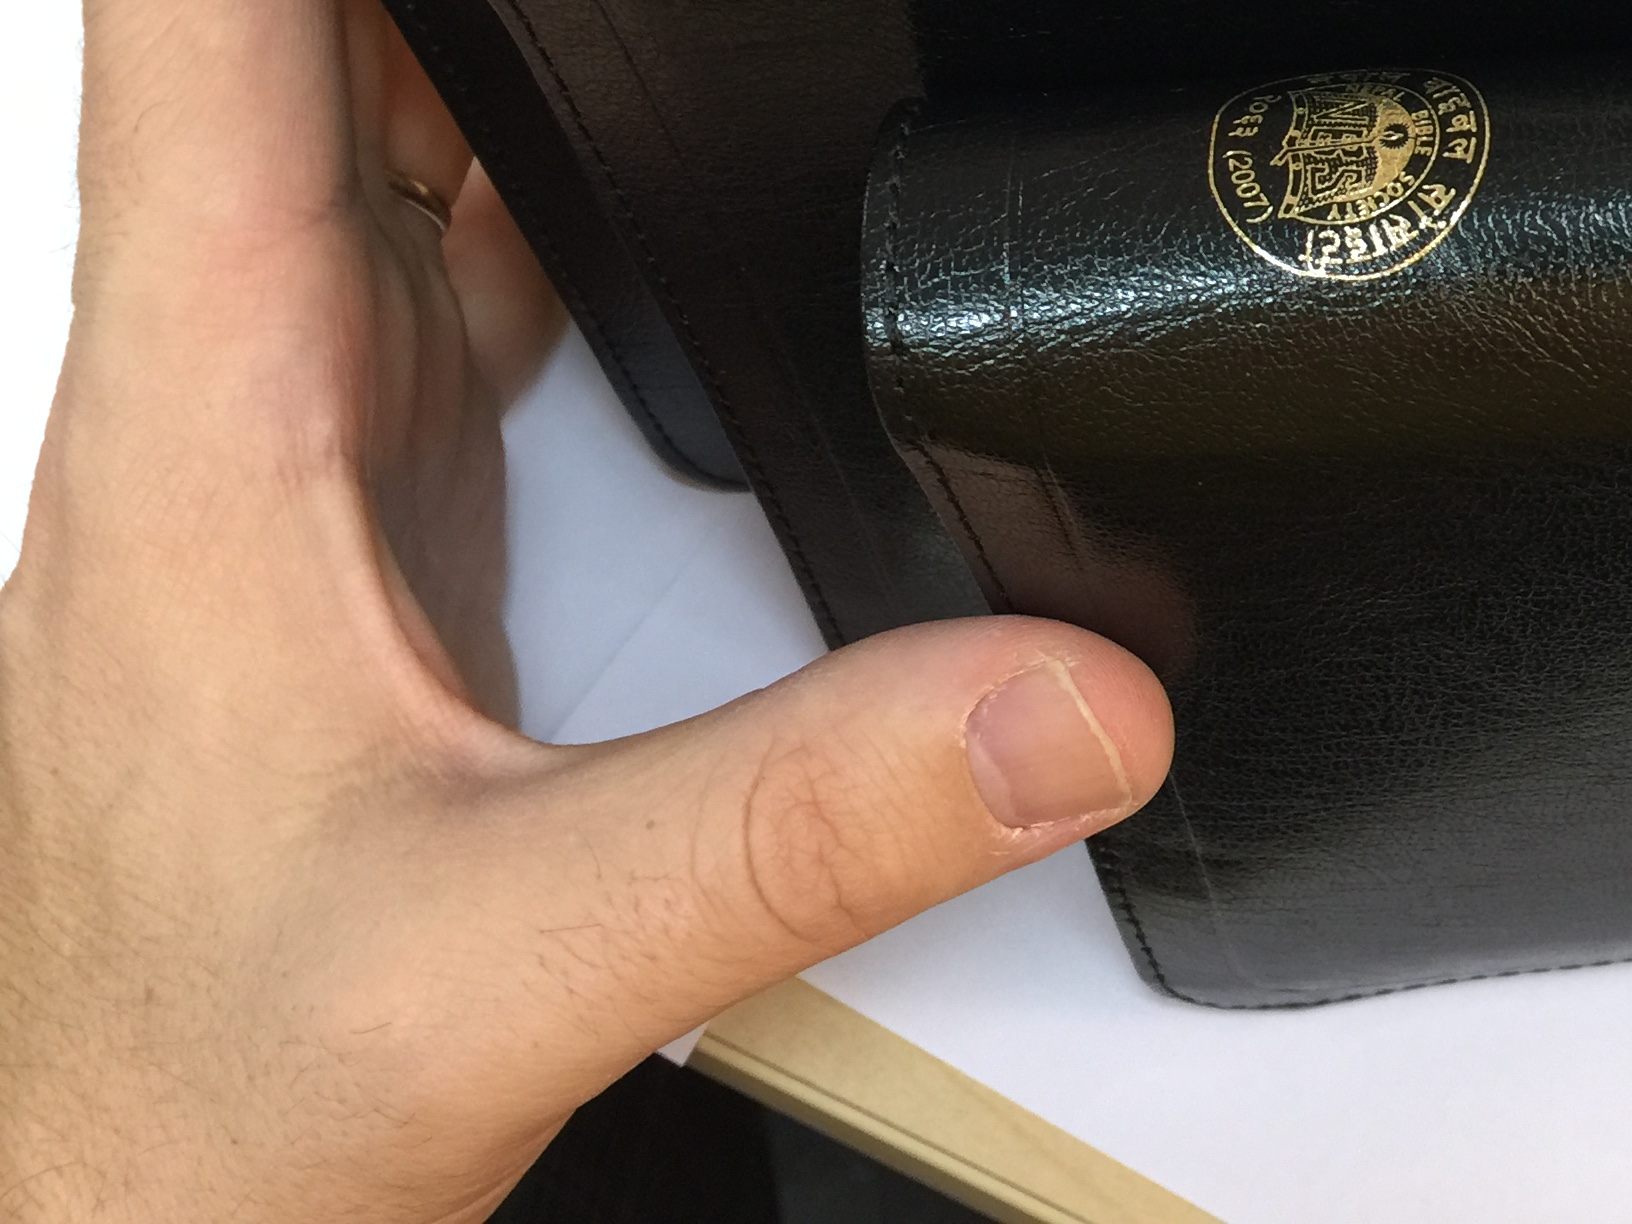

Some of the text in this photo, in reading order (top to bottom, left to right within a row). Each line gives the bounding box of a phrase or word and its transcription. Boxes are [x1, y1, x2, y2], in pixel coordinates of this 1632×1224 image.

[1410, 109, 1436, 157] BIBLE
[1220, 149, 1275, 225] (2007)
[1326, 170, 1416, 221] SOCIETY
